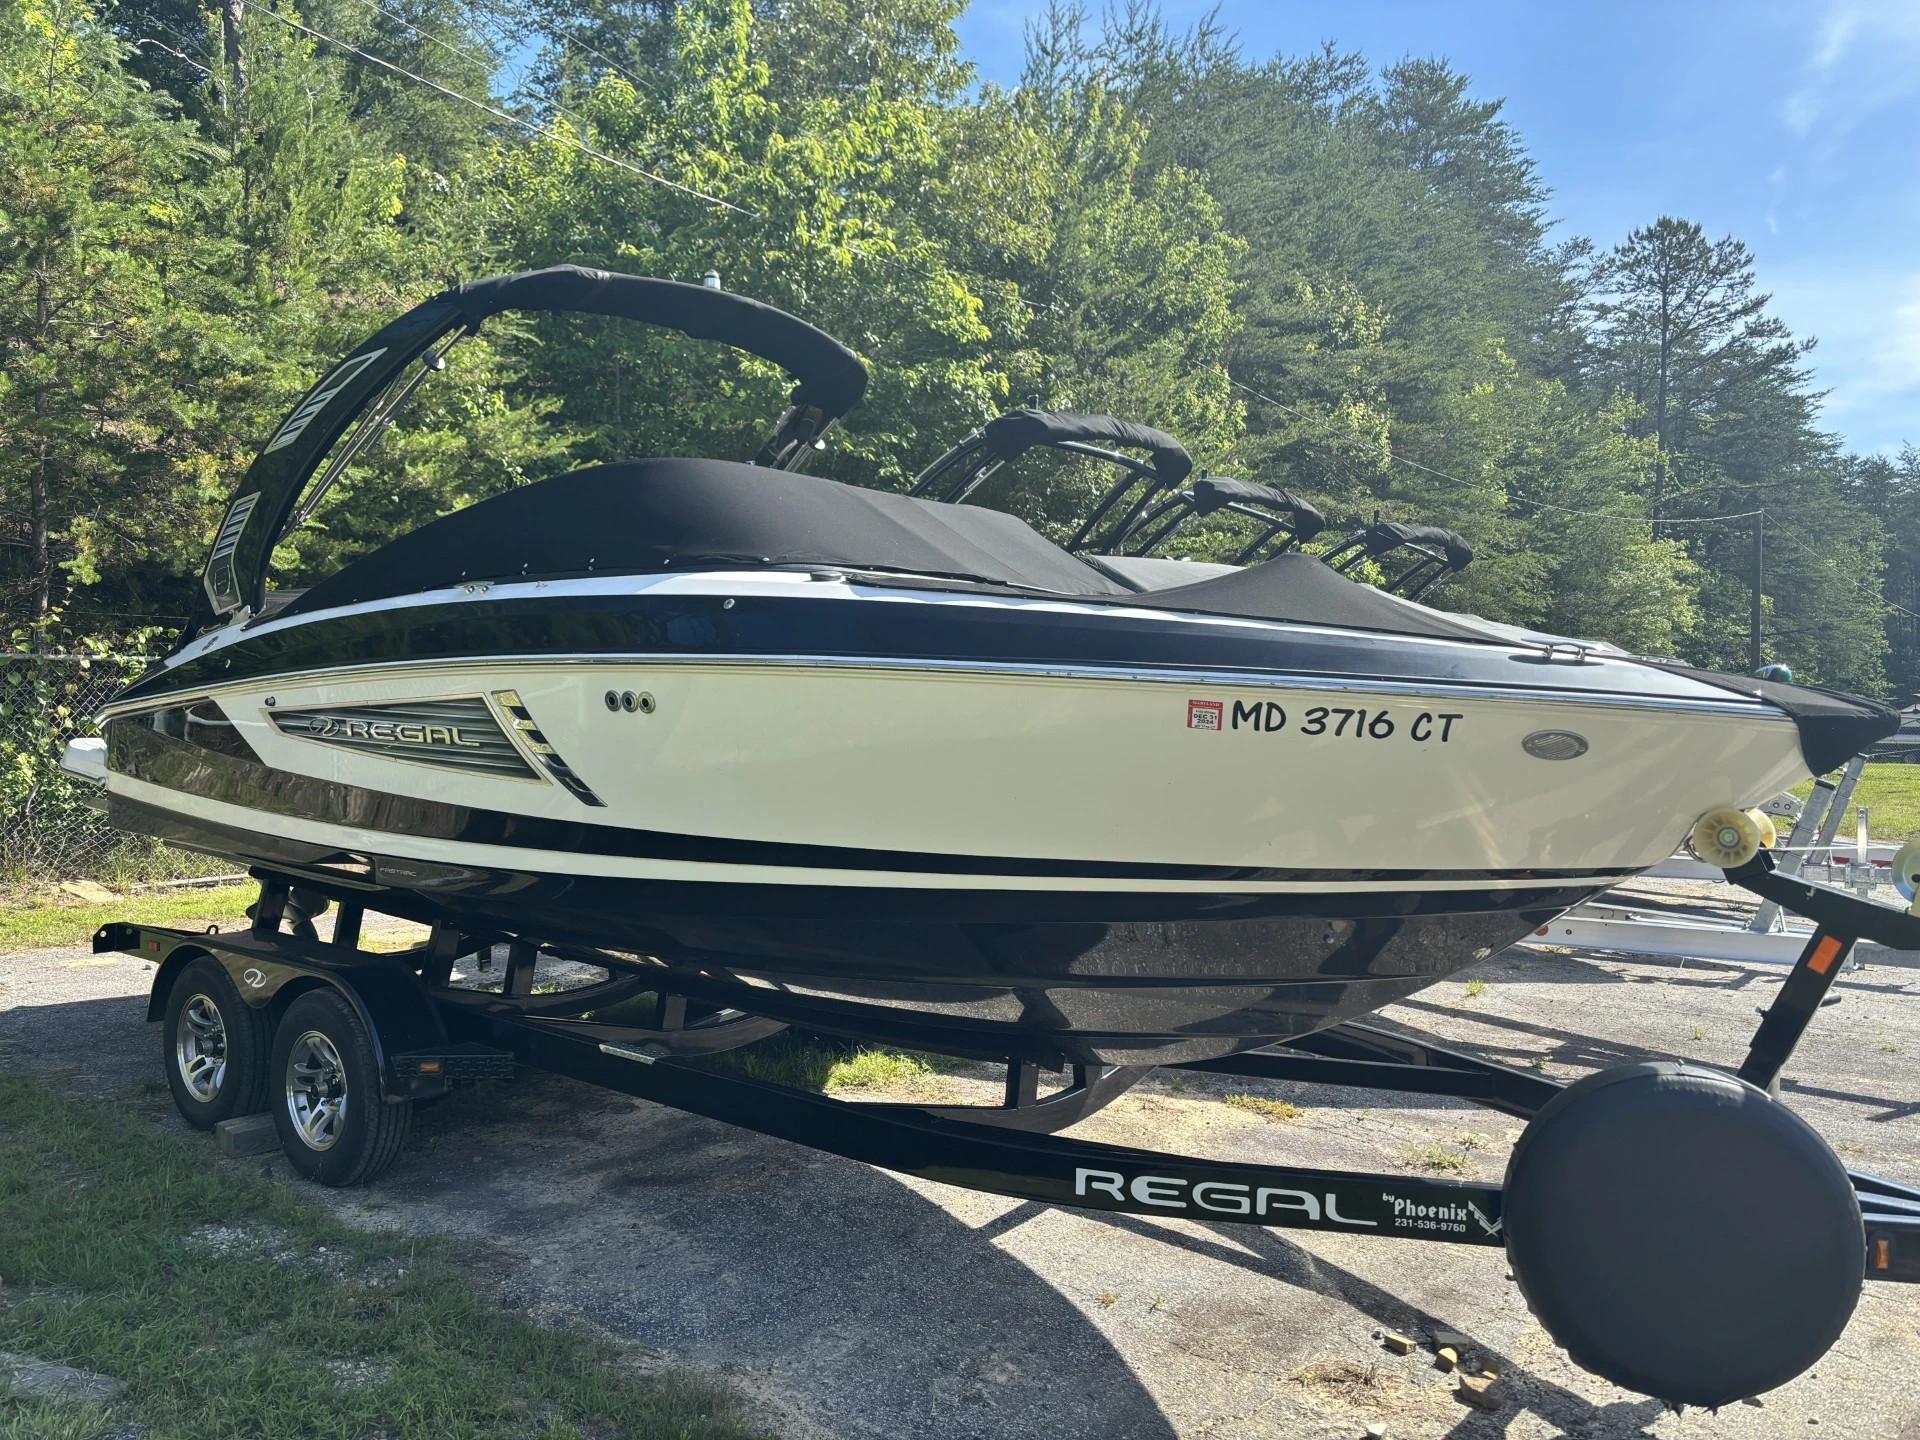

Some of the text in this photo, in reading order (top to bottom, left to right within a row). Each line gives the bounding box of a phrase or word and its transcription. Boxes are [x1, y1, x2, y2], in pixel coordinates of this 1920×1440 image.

[346, 719, 480, 747] REGAL
[1231, 700, 1464, 742] MD 3716 CT
[1075, 1167, 1379, 1226] REGAL
[1382, 1192, 1468, 1221] by Phoenix
[1394, 1217, 1467, 1233] 231-536-9760
